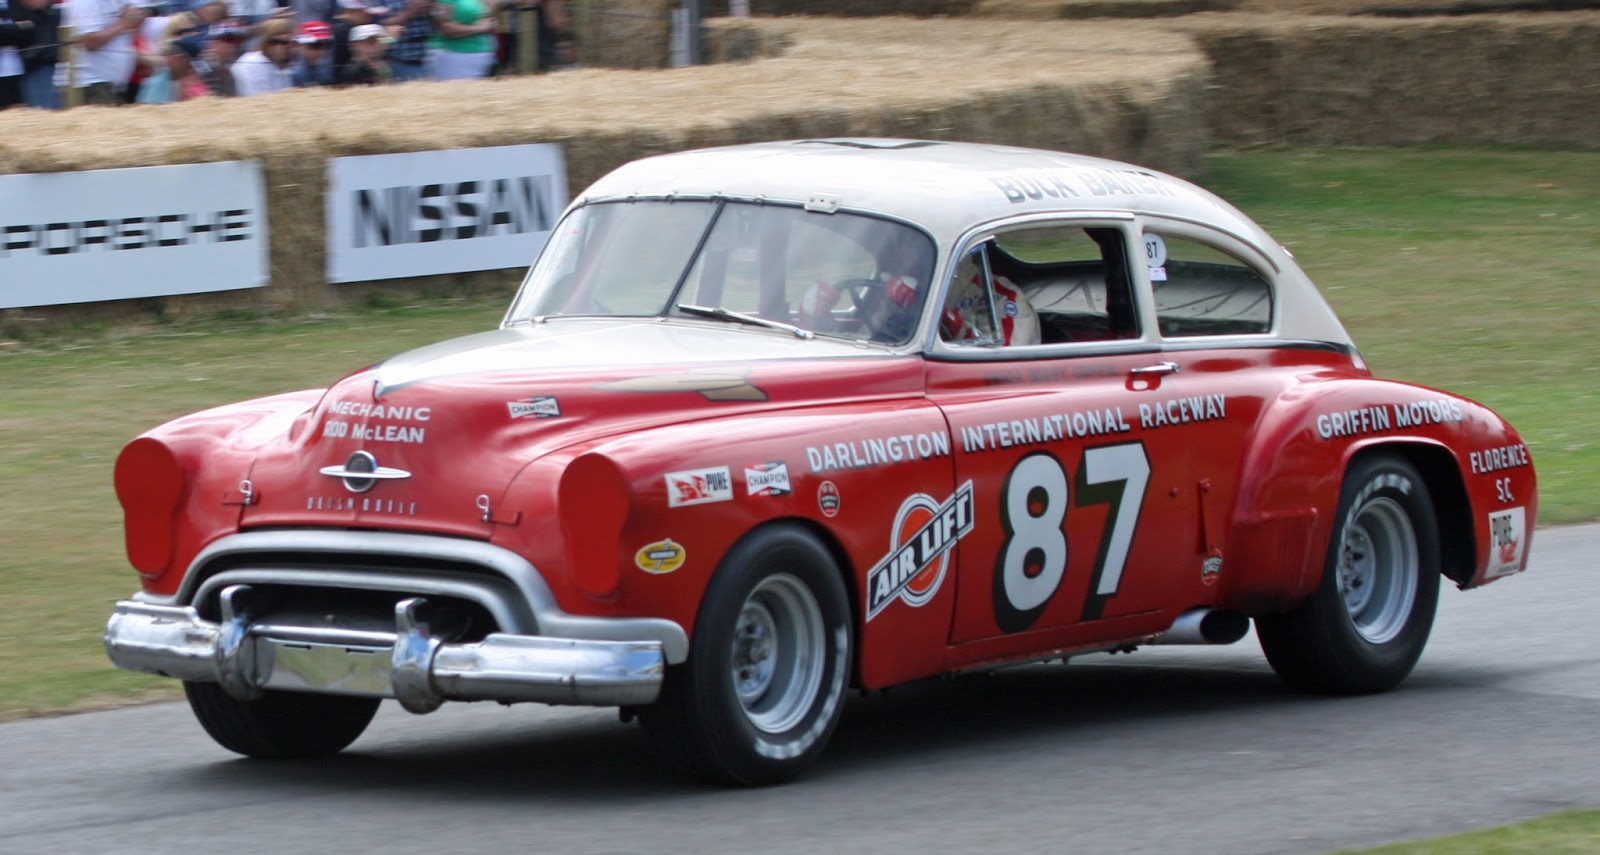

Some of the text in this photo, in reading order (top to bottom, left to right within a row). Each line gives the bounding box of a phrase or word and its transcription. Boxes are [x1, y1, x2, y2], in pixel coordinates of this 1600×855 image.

[989, 174, 1080, 204] BUCK
[351, 174, 552, 248] NISSAN
[1, 208, 254, 258] PORSCHE
[1146, 241, 1158, 259] 87
[328, 401, 431, 421] MECHANIC
[1316, 399, 1463, 438] GRIFFIN MOTORS
[323, 420, 425, 443] ROD McLEAN
[806, 393, 1227, 474] DARLINGTON INTERNATIONAL RACEWAY
[1469, 444, 1529, 474] FLORENCE
[705, 471, 729, 492] PURE
[748, 472, 788, 487] CHAMPION
[1000, 440, 1152, 617] 87
[873, 492, 969, 606] AIR LIFT
